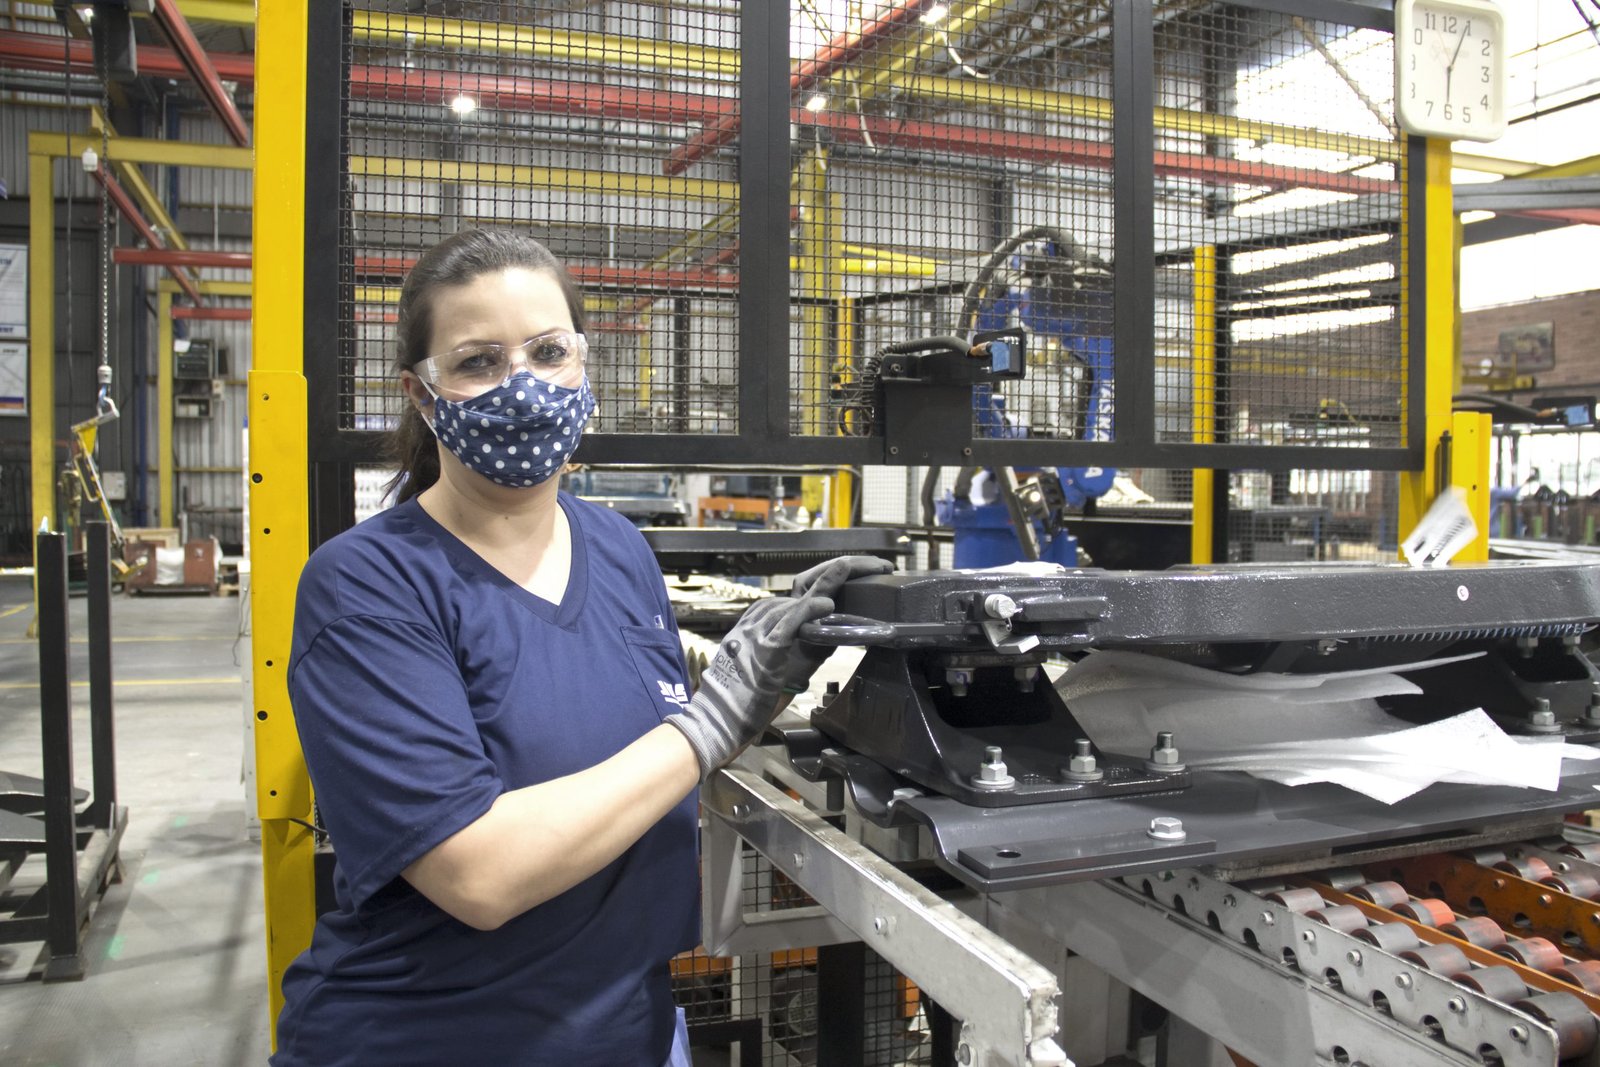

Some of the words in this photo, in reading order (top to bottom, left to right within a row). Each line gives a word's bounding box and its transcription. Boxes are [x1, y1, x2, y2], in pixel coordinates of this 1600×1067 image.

[1425, 12, 1436, 30] 11
[1442, 15, 1457, 34] 12
[1481, 39, 1490, 56] 2
[1481, 66, 1490, 83] 3
[1425, 100, 1434, 117] 7
[1480, 94, 1489, 110] 4
[1444, 103, 1452, 120] 6
[1462, 106, 1471, 123] 5
